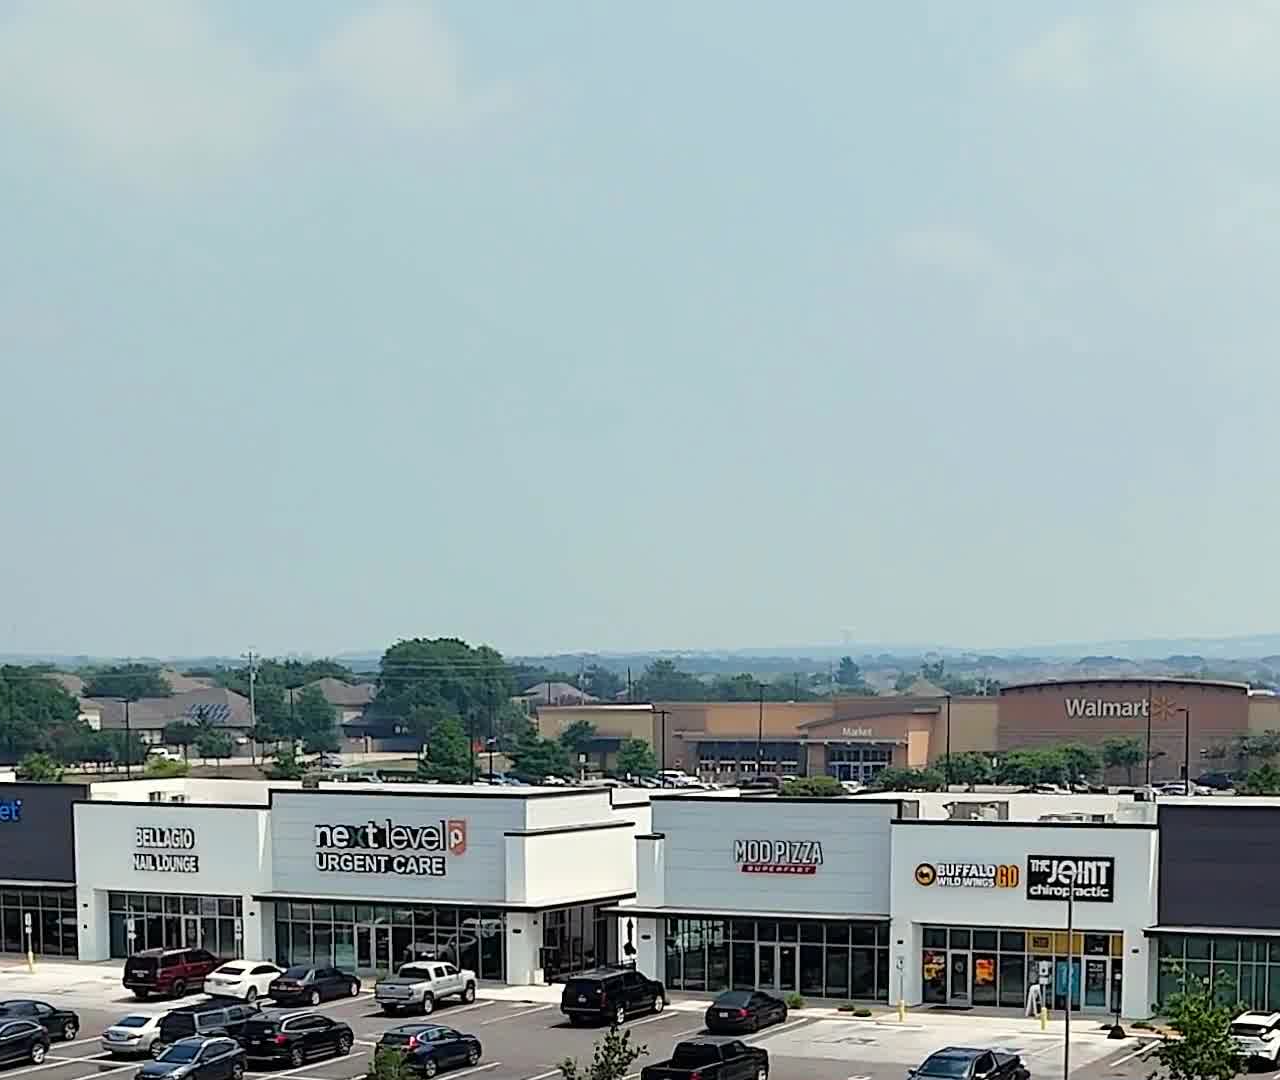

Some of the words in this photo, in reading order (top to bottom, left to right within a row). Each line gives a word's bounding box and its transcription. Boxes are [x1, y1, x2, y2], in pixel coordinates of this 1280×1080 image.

[1065, 698, 1149, 717] Walmart
[135, 828, 195, 849] BELLAGIO
[315, 820, 379, 848] next
[384, 820, 445, 850] level
[735, 840, 772, 863] MOD
[775, 840, 823, 865] PIZZA
[133, 854, 156, 871] NAIL
[157, 855, 198, 872] LOUNGE
[315, 853, 389, 873] URGENT
[392, 856, 444, 875] CARE
[937, 864, 995, 877] BUFFALO
[1047, 860, 1111, 885] JOINT
[937, 876, 962, 887] WILD
[962, 878, 995, 888] WINGS
[1029, 884, 1110, 897] chiropractic
